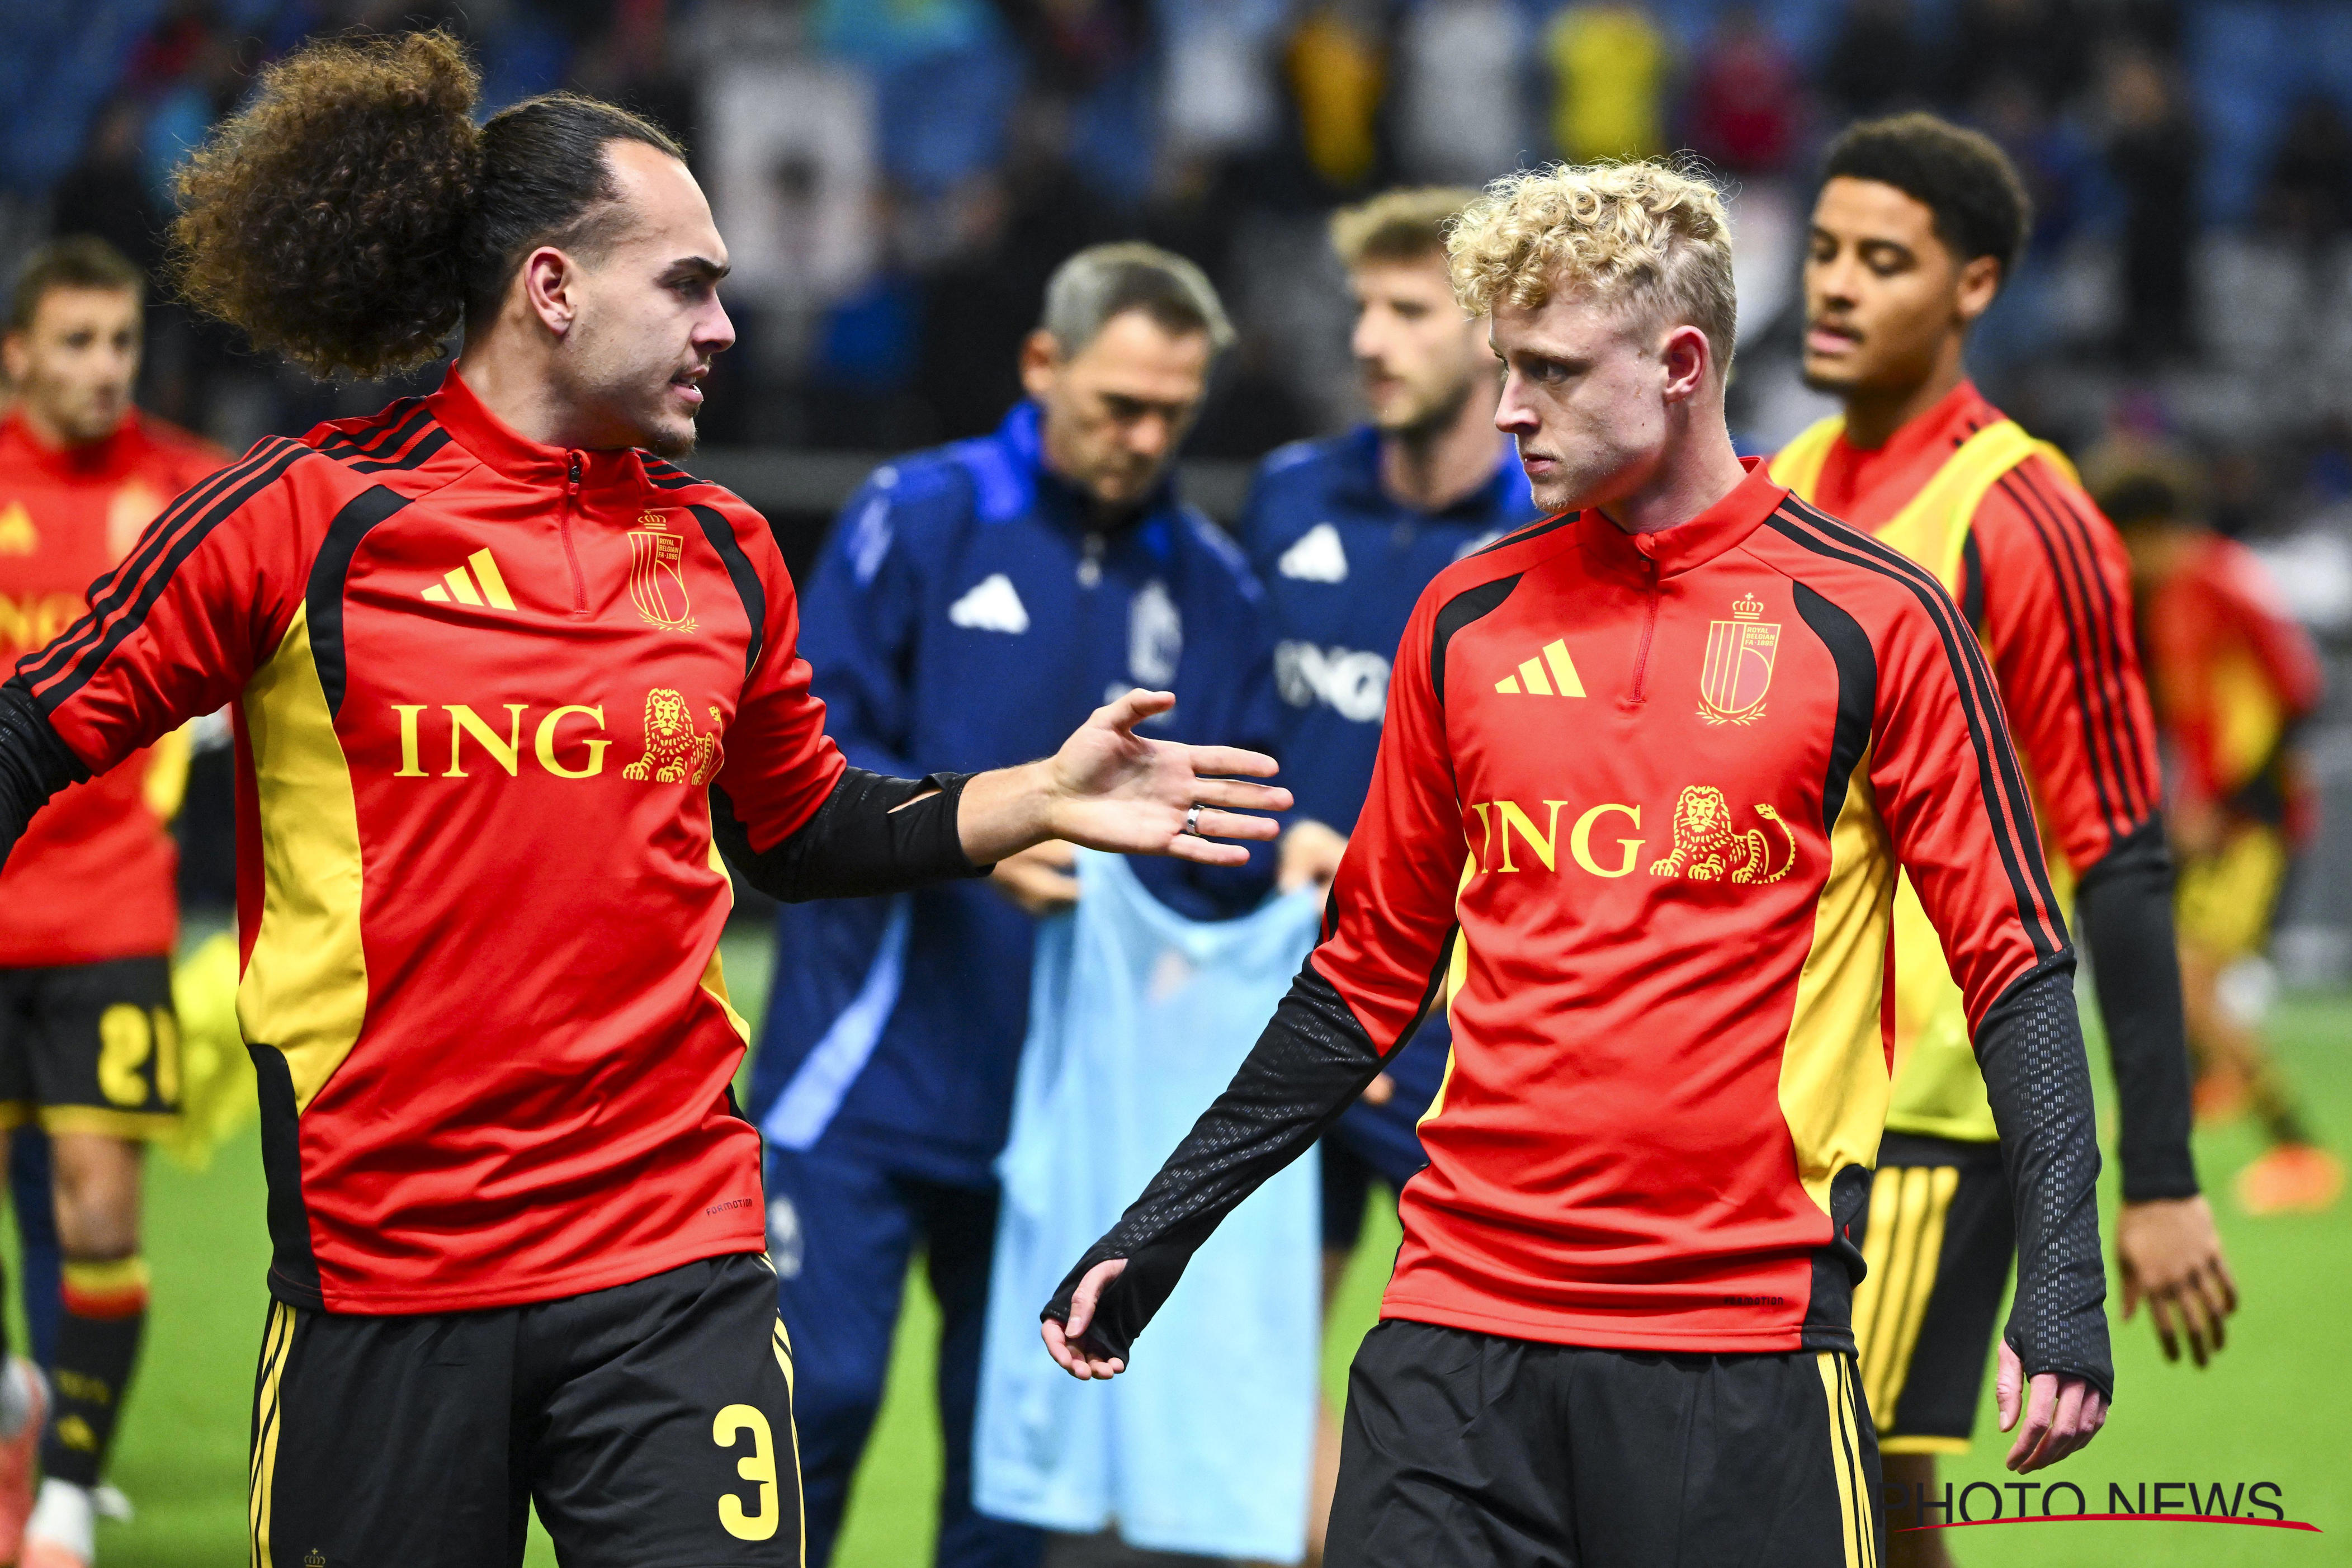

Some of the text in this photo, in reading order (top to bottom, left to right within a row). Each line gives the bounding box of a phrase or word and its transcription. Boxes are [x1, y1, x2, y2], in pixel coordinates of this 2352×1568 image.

[659, 545, 679, 553] BELGIAN
[391, 703, 613, 779] ING
[1472, 800, 1646, 878] ING
[713, 1404, 780, 1541] 3
